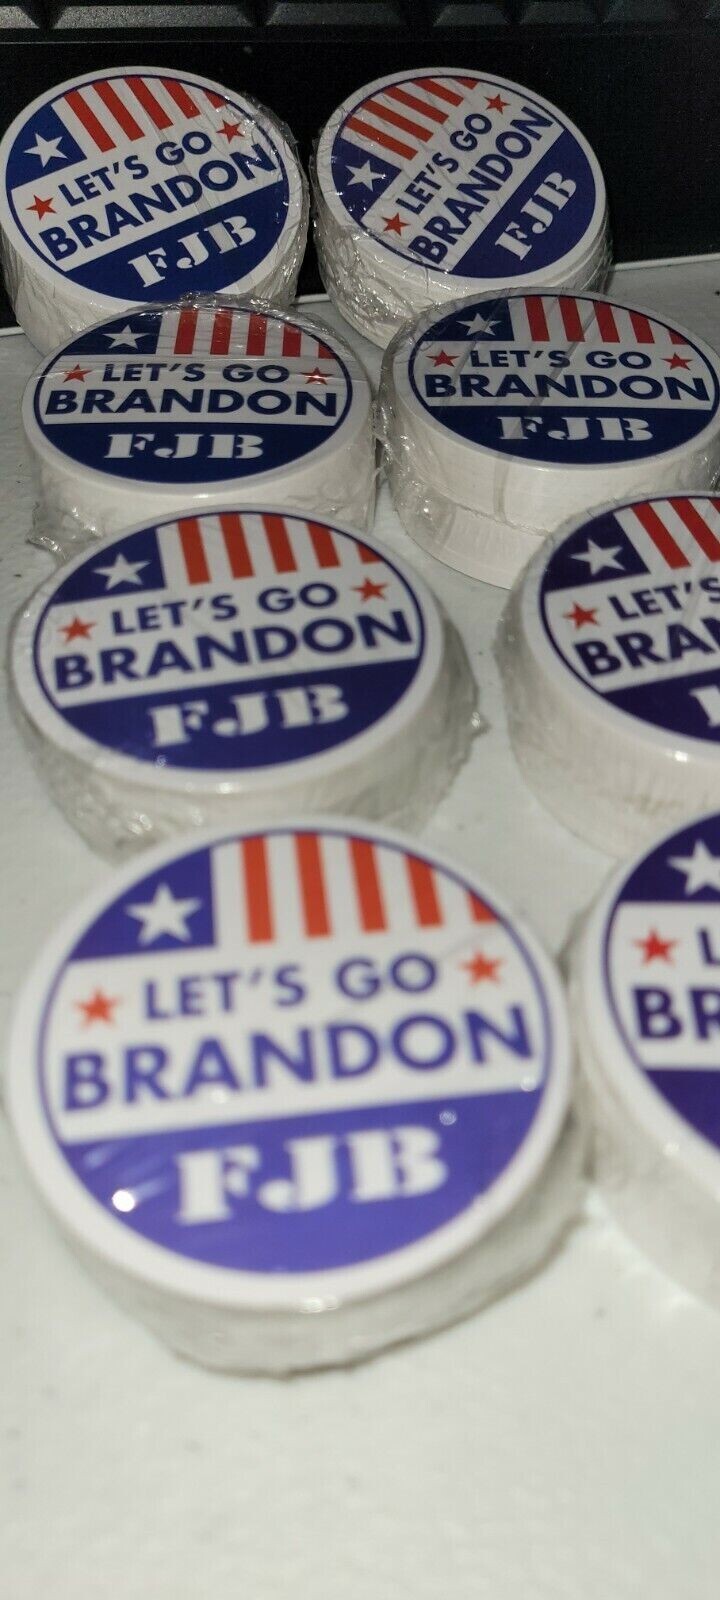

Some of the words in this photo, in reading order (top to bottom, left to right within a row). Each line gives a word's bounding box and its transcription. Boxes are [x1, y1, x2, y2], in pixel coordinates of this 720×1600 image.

[58, 155, 149, 206] LET'S
[155, 131, 212, 166] GO
[395, 152, 459, 214] LET'S
[450, 113, 492, 151] GO
[407, 106, 554, 264] BRANDON
[38, 143, 278, 262] BRANDON
[494, 171, 577, 261] FJB
[127, 215, 257, 288] FJB
[102, 363, 206, 382] LET'S
[222, 364, 290, 383] GO
[424, 374, 711, 401] BRANDON
[469, 350, 571, 368] LET'S
[585, 351, 652, 369] GO
[45, 388, 337, 417] BRANDON
[497, 416, 653, 441] FJB
[103, 433, 264, 459] FJB
[111, 594, 239, 636] LET'S
[258, 582, 338, 613] GO
[53, 610, 413, 692] BRANDON
[148, 683, 348, 747] FJB
[143, 964, 308, 1020] LET'S
[334, 952, 439, 1002] GO
[62, 1003, 534, 1113] BRANDON
[174, 1126, 449, 1225] FJB
